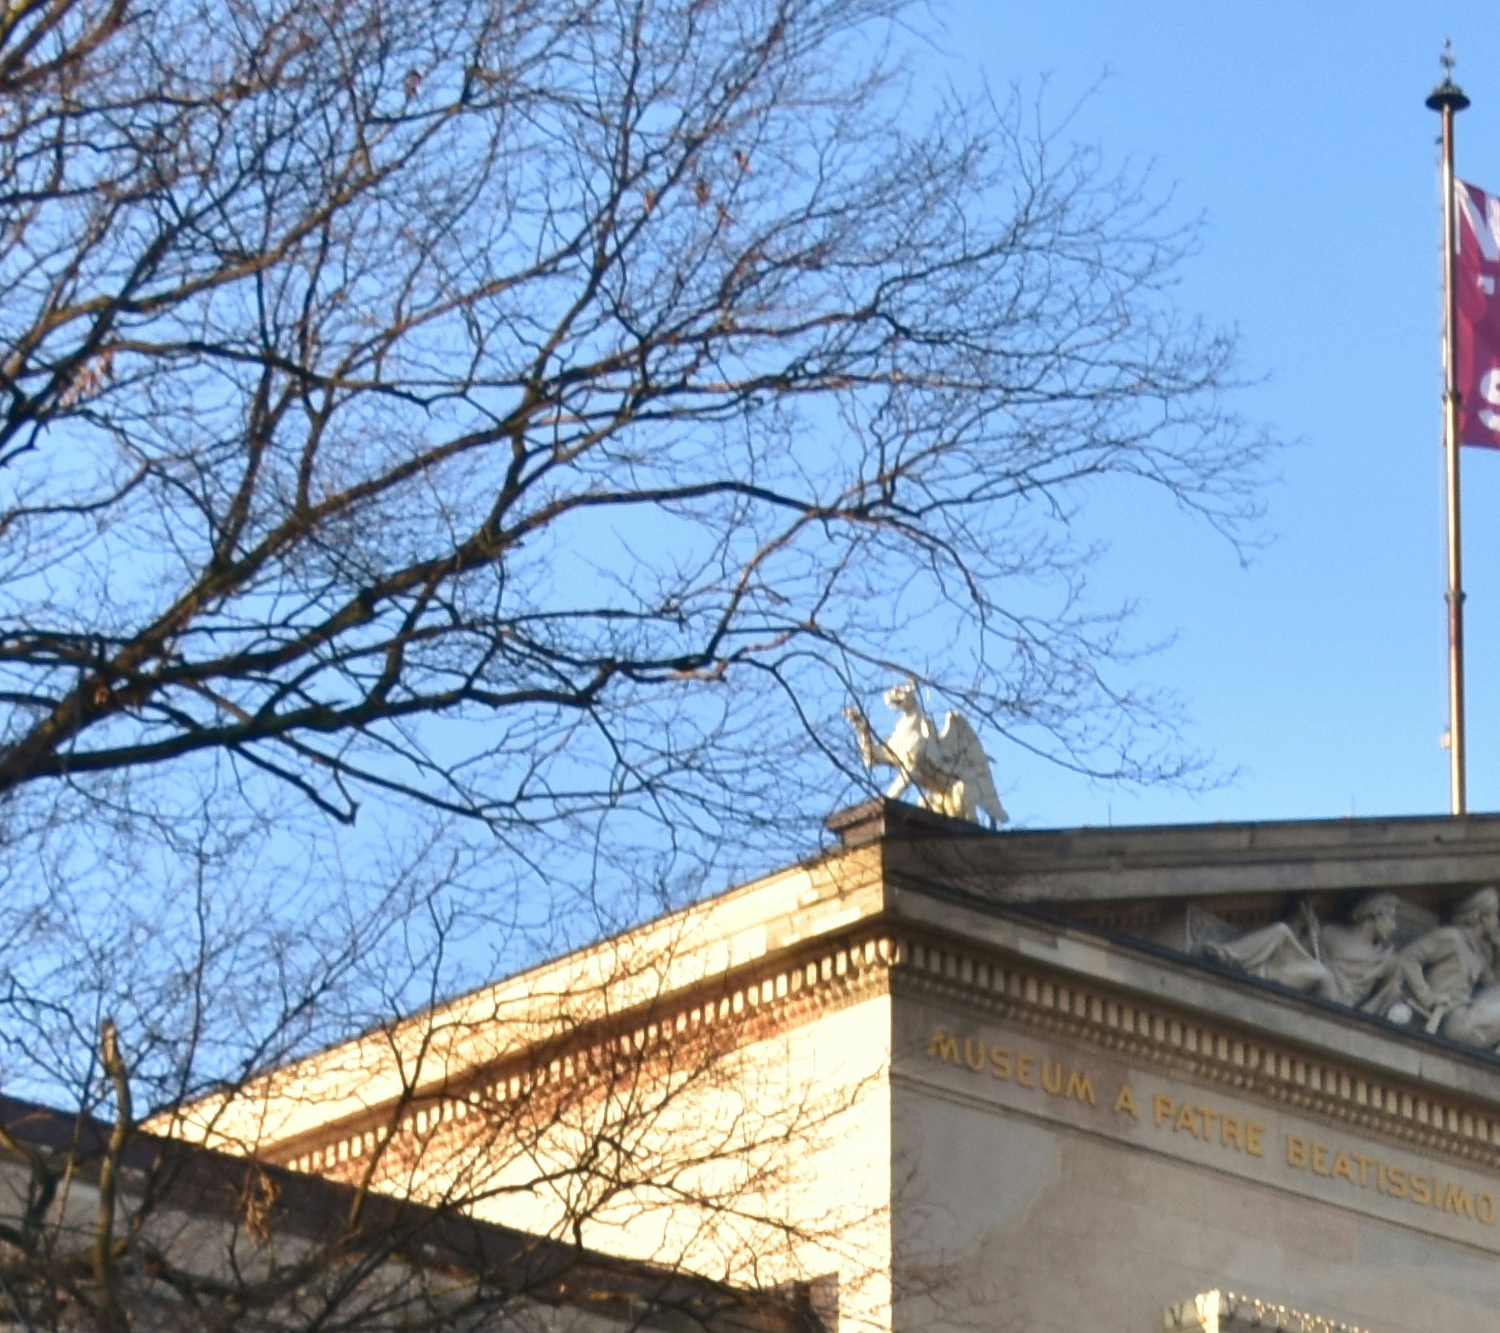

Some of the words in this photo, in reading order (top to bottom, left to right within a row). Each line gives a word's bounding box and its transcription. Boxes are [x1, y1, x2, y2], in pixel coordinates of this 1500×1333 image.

[927, 1026, 1097, 1106] MUSEUM
[1113, 1084, 1138, 1121] A
[1154, 1092, 1266, 1158] PATRE
[1287, 1134, 1498, 1226] BEATISSIMO
